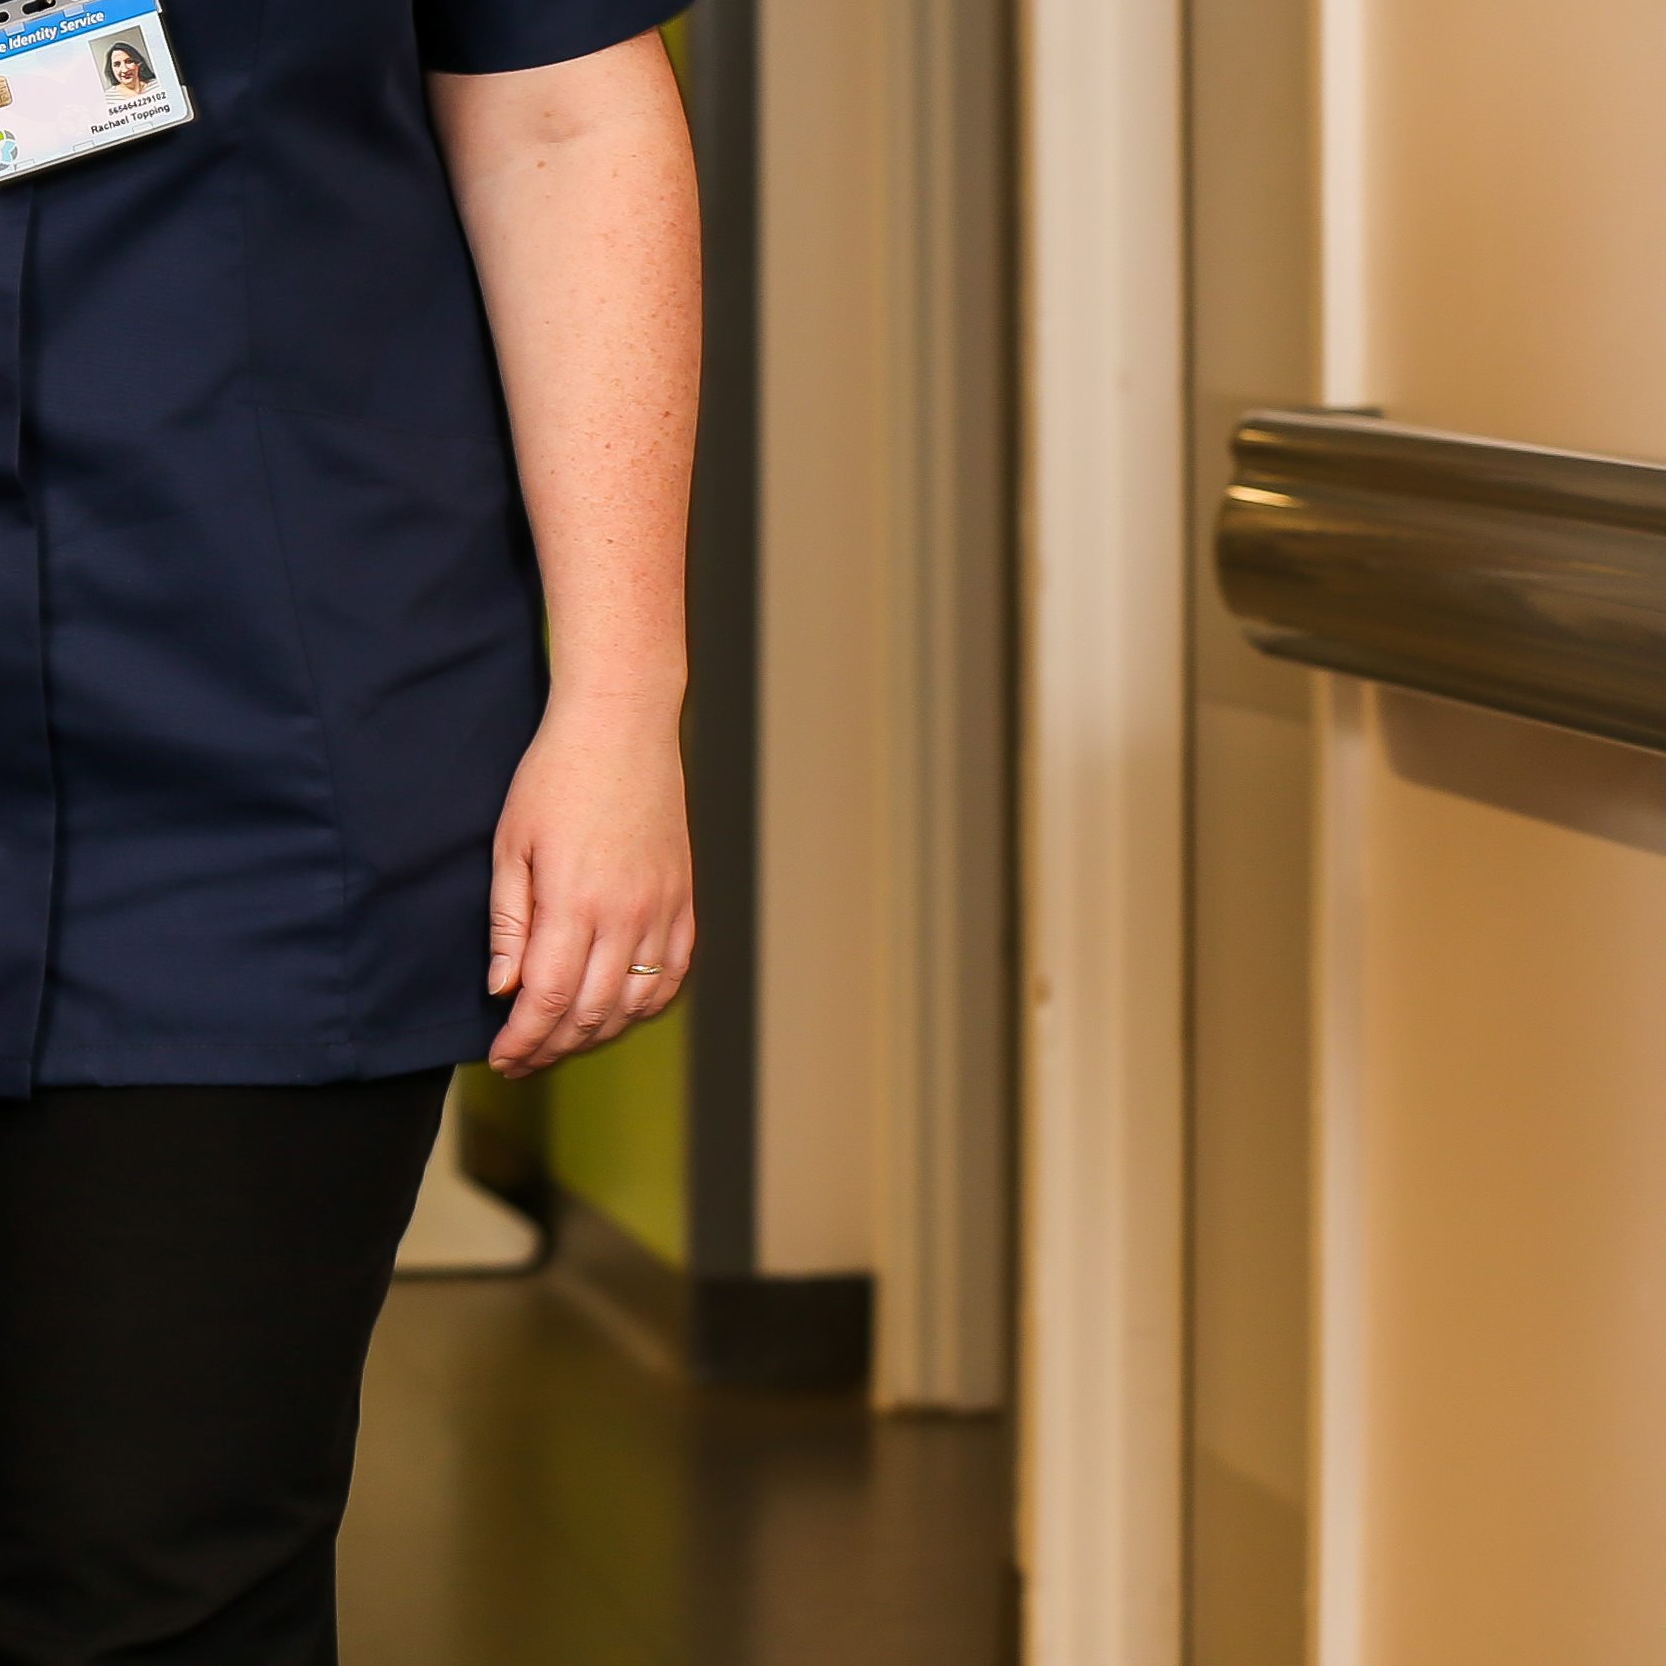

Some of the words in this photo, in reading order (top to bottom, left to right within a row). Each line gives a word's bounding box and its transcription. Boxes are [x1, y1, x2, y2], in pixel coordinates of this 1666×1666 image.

[8, 25, 58, 50] Identity
[59, 11, 105, 33] Service
[90, 115, 130, 135] Rachael
[131, 103, 171, 123] Topping
